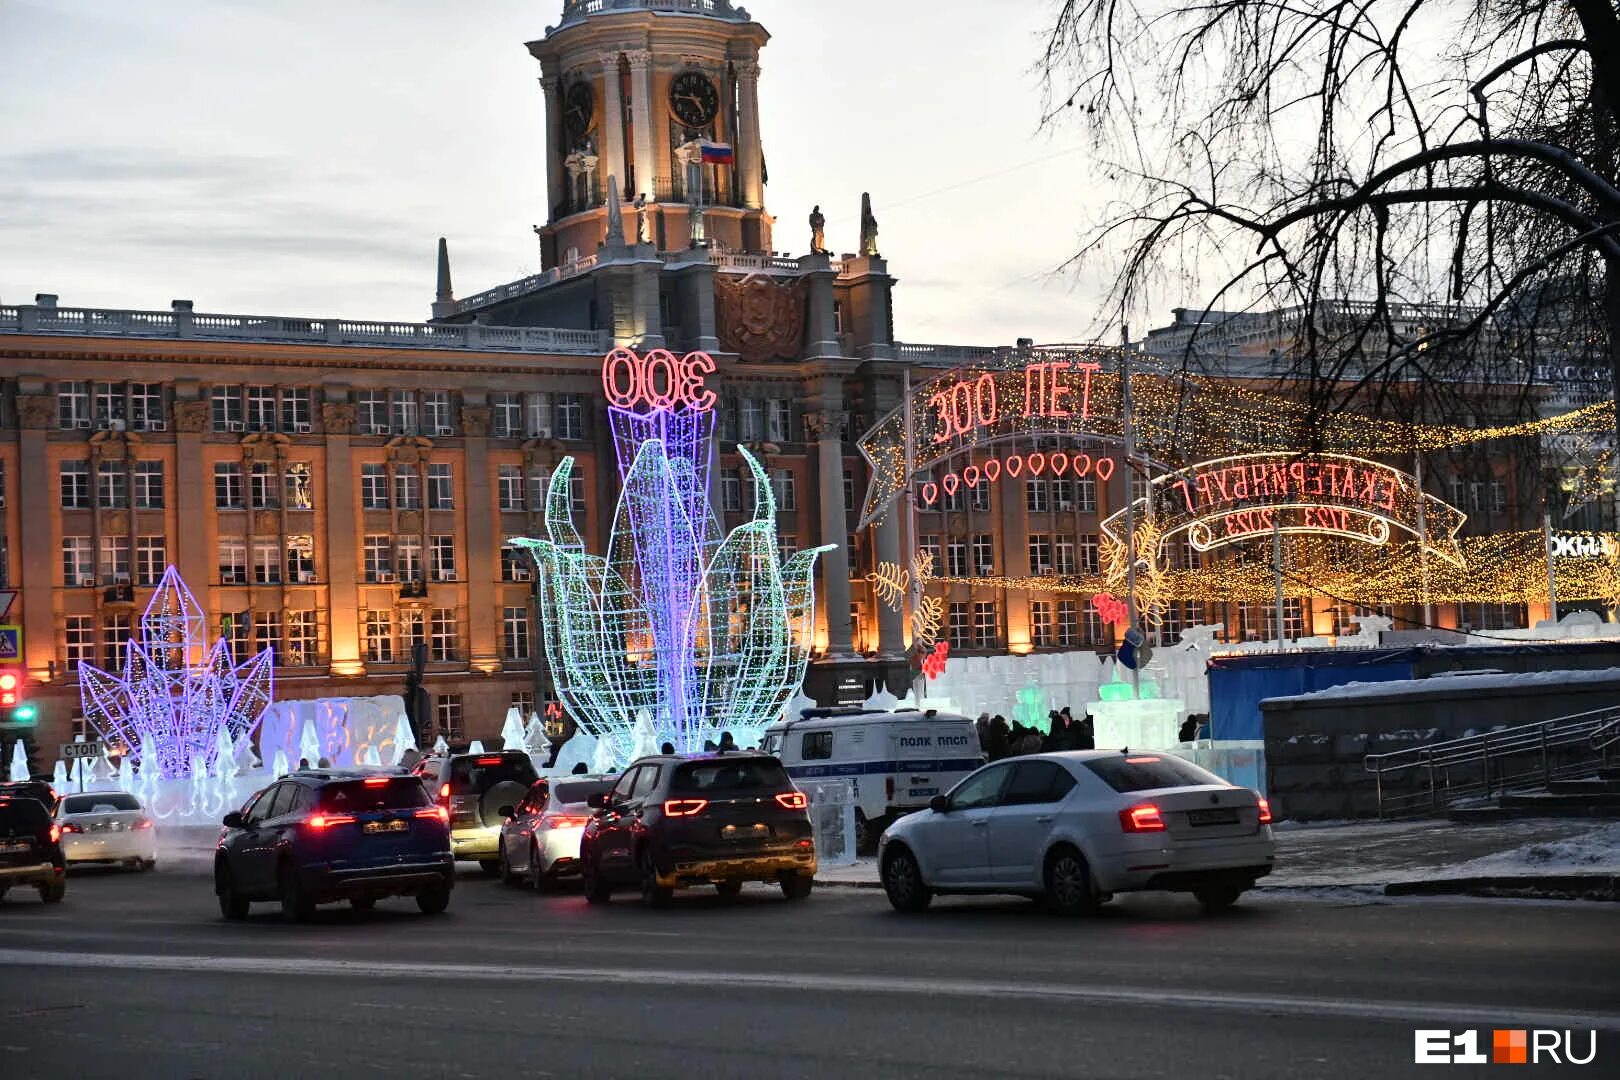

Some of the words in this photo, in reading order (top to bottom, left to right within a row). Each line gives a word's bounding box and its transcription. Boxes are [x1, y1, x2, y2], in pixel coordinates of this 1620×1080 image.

[928, 373, 997, 444] 300
[900, 736, 931, 746] ПОЛК
[937, 735, 968, 745] ППСП
[64, 743, 97, 755] СТОП
